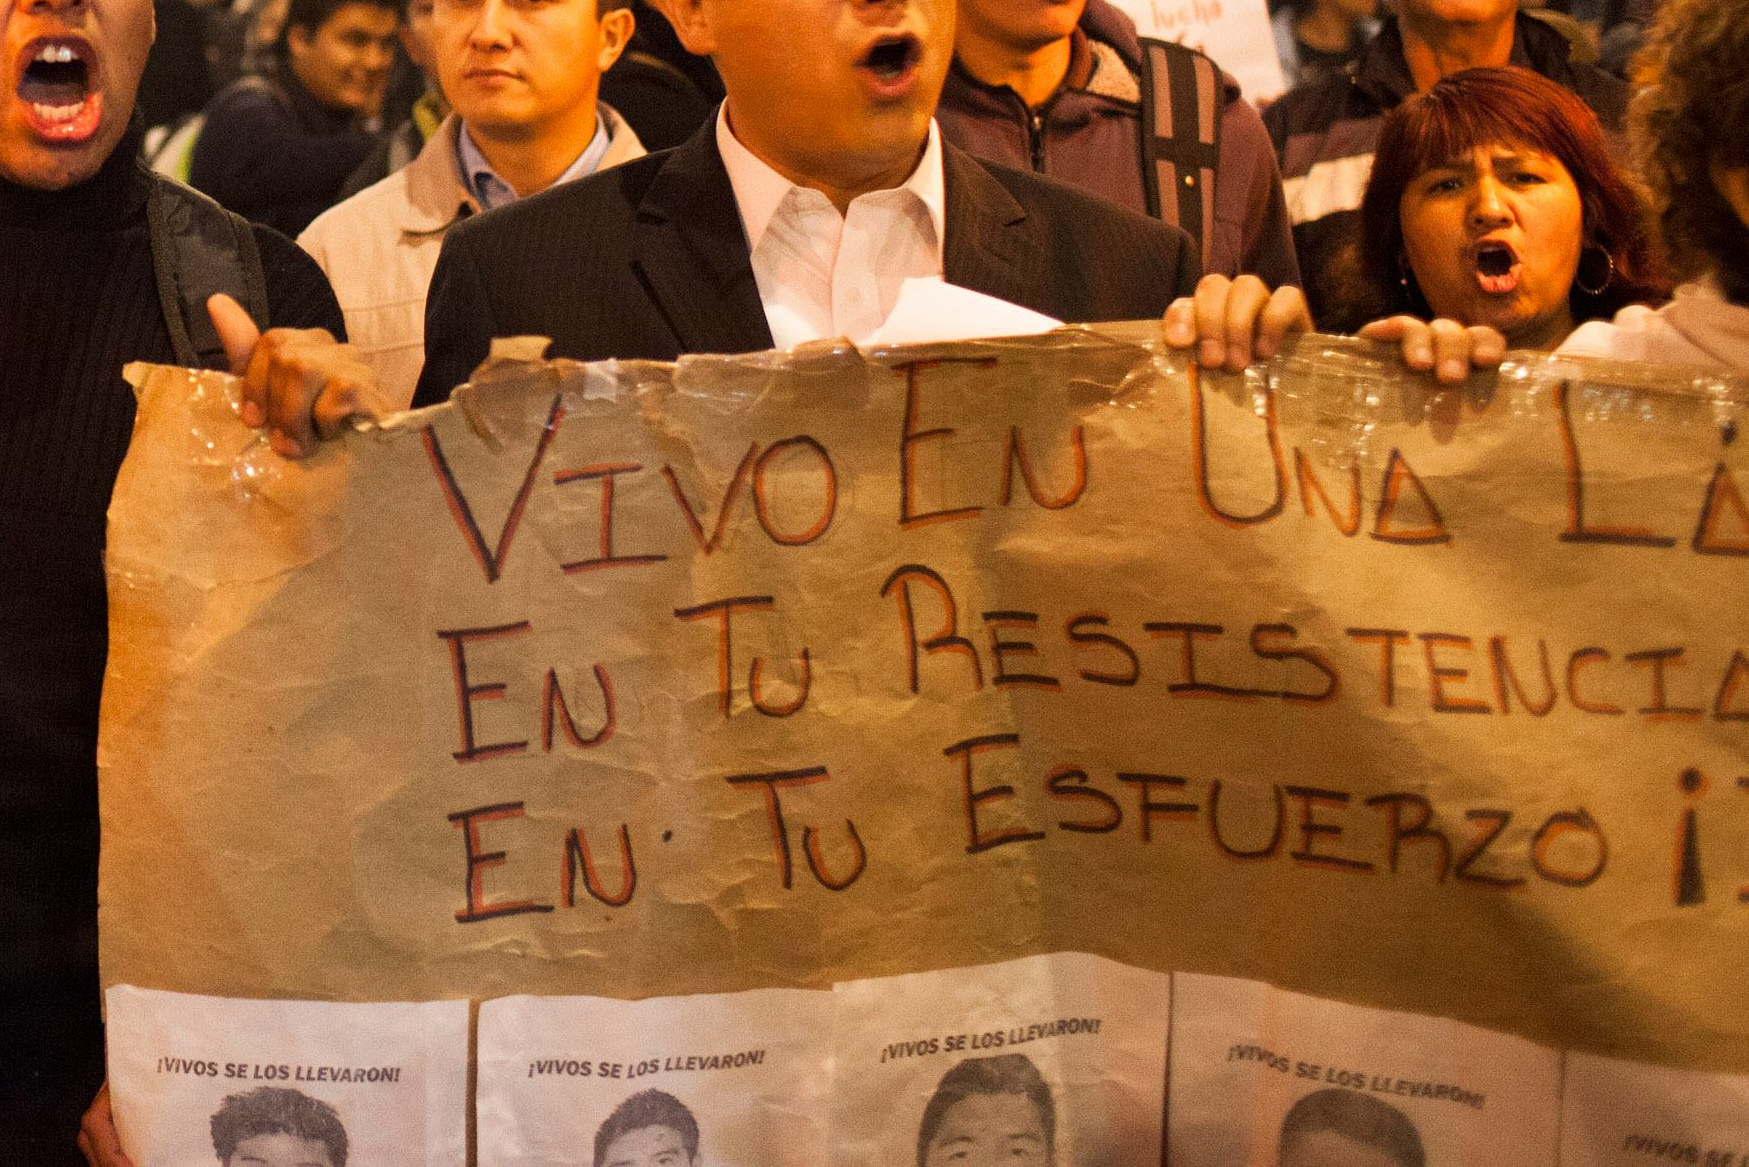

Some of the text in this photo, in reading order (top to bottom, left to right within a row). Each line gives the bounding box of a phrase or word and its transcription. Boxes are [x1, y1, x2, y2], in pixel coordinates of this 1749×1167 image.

[436, 619, 618, 765] EN
[673, 594, 813, 720] TU
[725, 765, 869, 892] TU
[943, 732, 1610, 888] ESFUERZO
[527, 1048, 767, 1080] ¡VIVOS SE LOS LLEVARON!
[879, 1017, 1103, 1065] ¡VIVOS SE LOS LLEVARON!
[156, 1056, 402, 1084] ¡VIVOS SE LOS LLEVARON!
